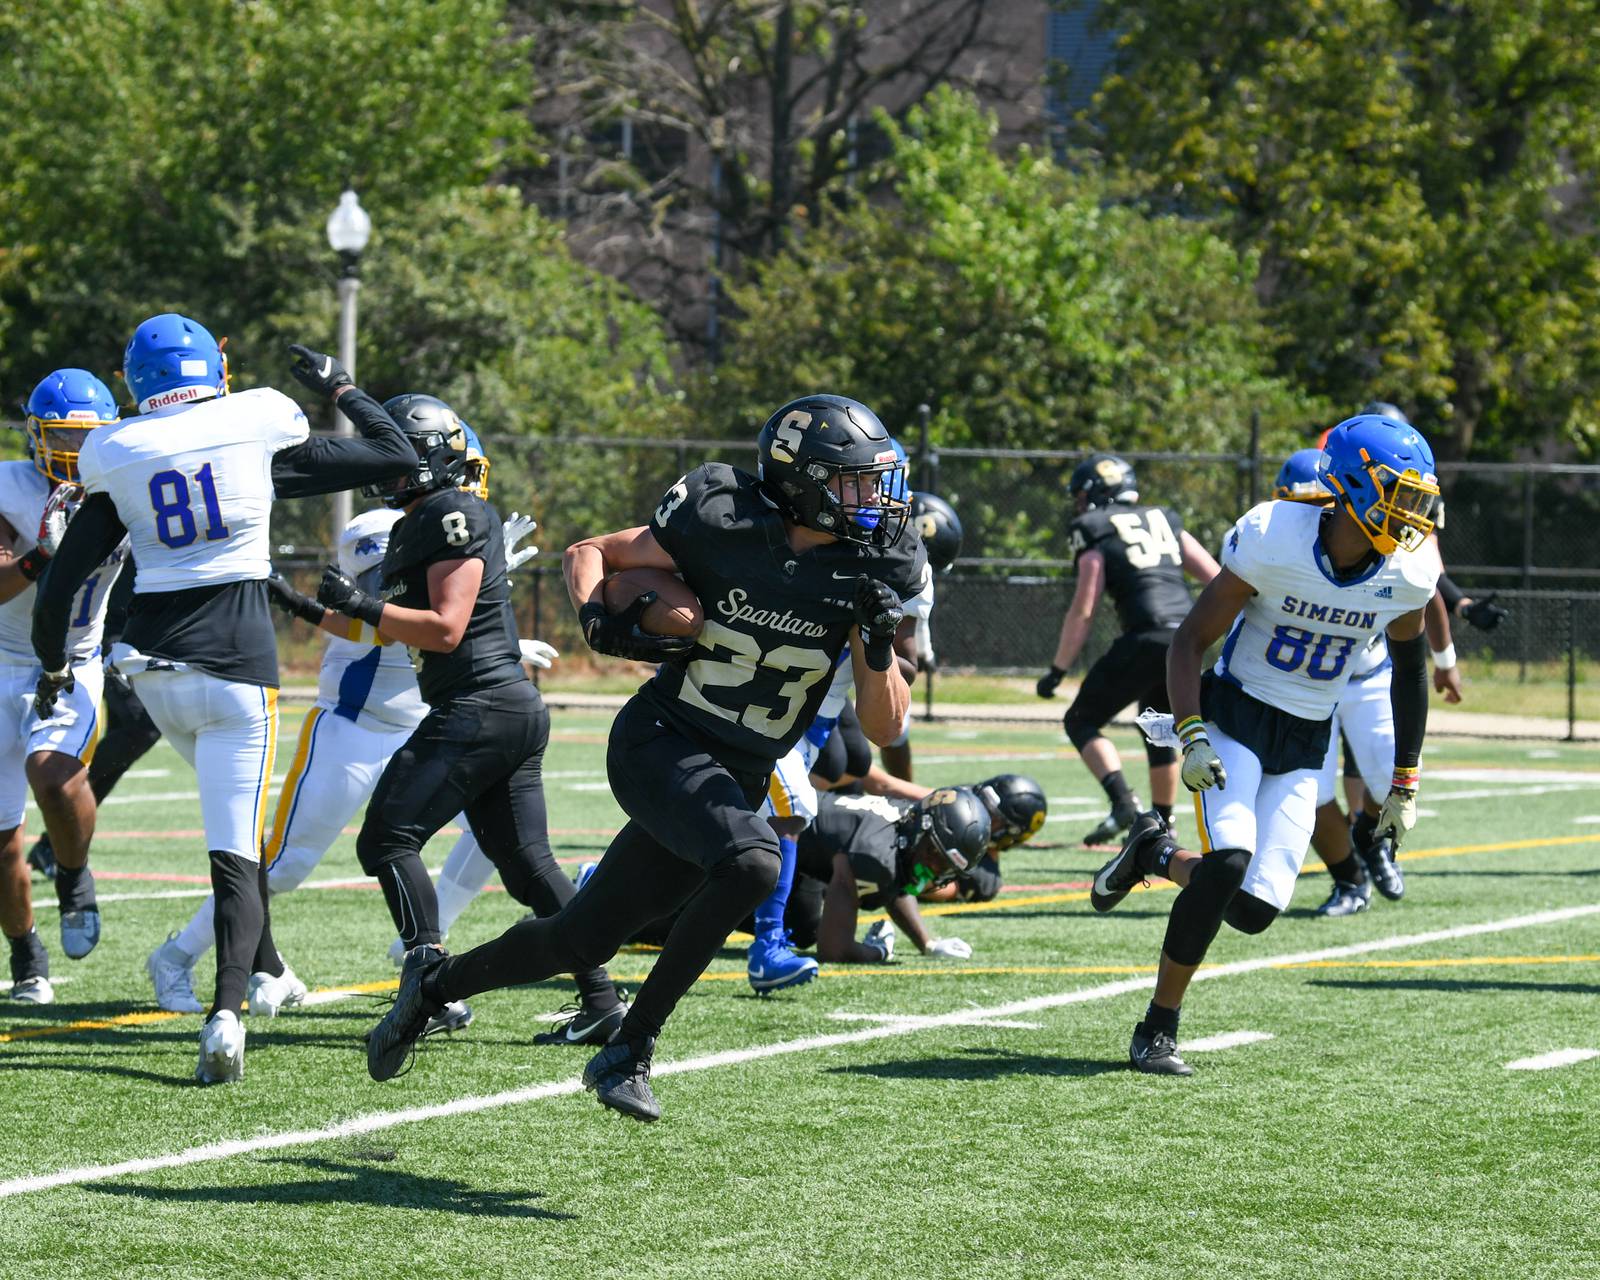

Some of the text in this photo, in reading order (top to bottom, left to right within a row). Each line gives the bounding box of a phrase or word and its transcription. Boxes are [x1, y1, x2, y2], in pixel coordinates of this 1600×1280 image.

[147, 389, 198, 410] Riddell
[770, 409, 813, 464] S
[147, 462, 231, 550] 81
[441, 510, 471, 547] 8
[654, 474, 689, 529] 3
[1109, 507, 1184, 570] 54
[717, 588, 829, 638] Spartans
[1281, 594, 1378, 630] SIMEON
[677, 618, 833, 741] 23
[1264, 623, 1358, 682] 80
